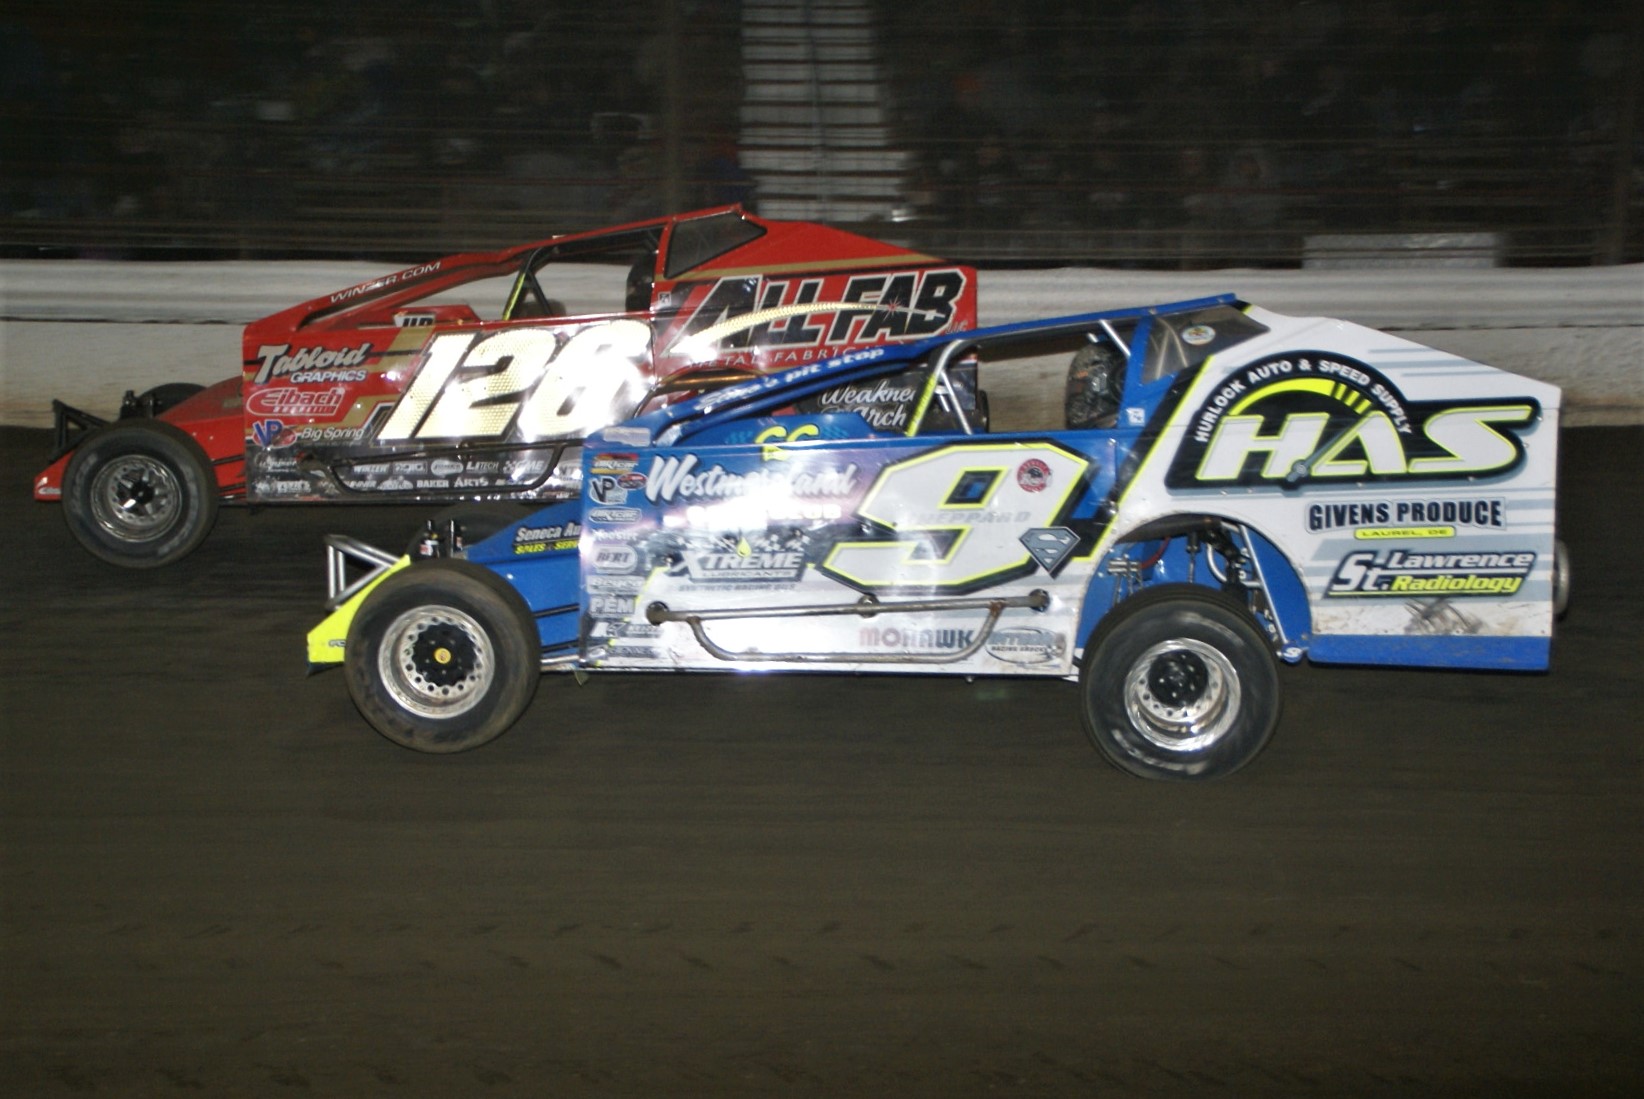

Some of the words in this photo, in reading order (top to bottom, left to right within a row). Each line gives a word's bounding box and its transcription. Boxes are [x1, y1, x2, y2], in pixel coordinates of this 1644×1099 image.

[826, 268, 967, 347] FAB
[254, 342, 373, 384] Tabloid
[827, 347, 886, 369] stop
[290, 371, 368, 383] GRAPHICS
[261, 388, 345, 406] Eibach
[1195, 379, 1247, 443] HURLOCK
[1248, 360, 1293, 384] AUTO
[1298, 357, 1313, 371] &
[1319, 359, 1371, 387] SPEED
[1369, 383, 1413, 436] SUPPLY
[253, 420, 284, 448] VP
[301, 427, 323, 441] Big
[324, 427, 364, 441] Spring
[1195, 405, 1533, 480] HAS
[822, 441, 1091, 588] 9
[1309, 502, 1389, 531] GIVENS
[1397, 500, 1502, 528] PRODUCE
[515, 526, 562, 543] Seneca
[670, 551, 804, 572] XTREME
[1334, 552, 1388, 591] St.
[1387, 551, 1534, 570] Lawrence
[1391, 574, 1523, 593] Radiology
[858, 627, 974, 649] MOHAWK
